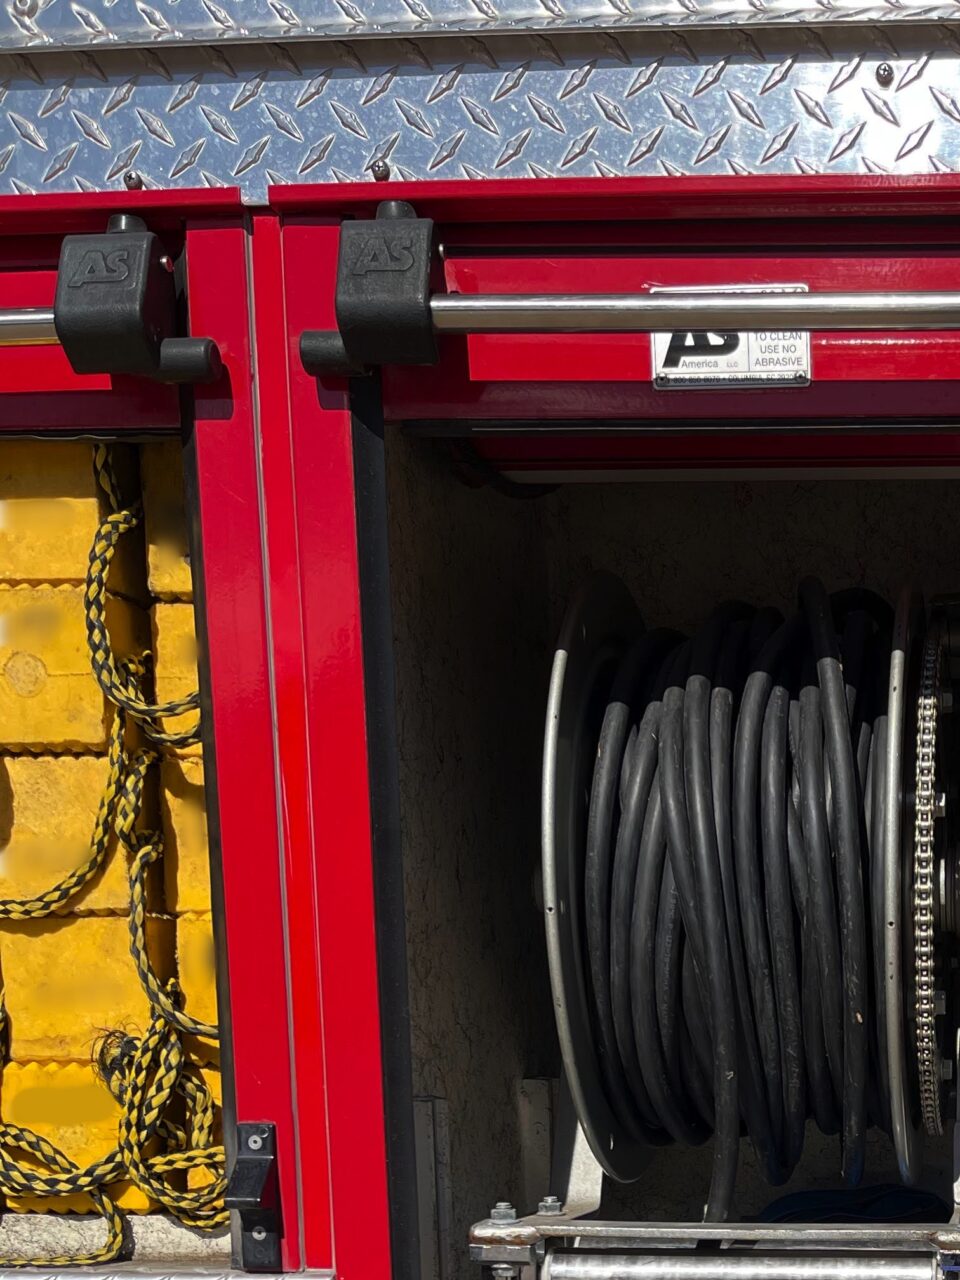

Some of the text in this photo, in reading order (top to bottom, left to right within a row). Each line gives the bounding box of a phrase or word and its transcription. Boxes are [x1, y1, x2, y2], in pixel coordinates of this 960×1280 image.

[68, 250, 131, 287] AS
[755, 331, 802, 341] TO CLEAN
[760, 344, 797, 354] USE NO
[681, 360, 719, 369] America
[754, 357, 803, 367] ABRASIVE
